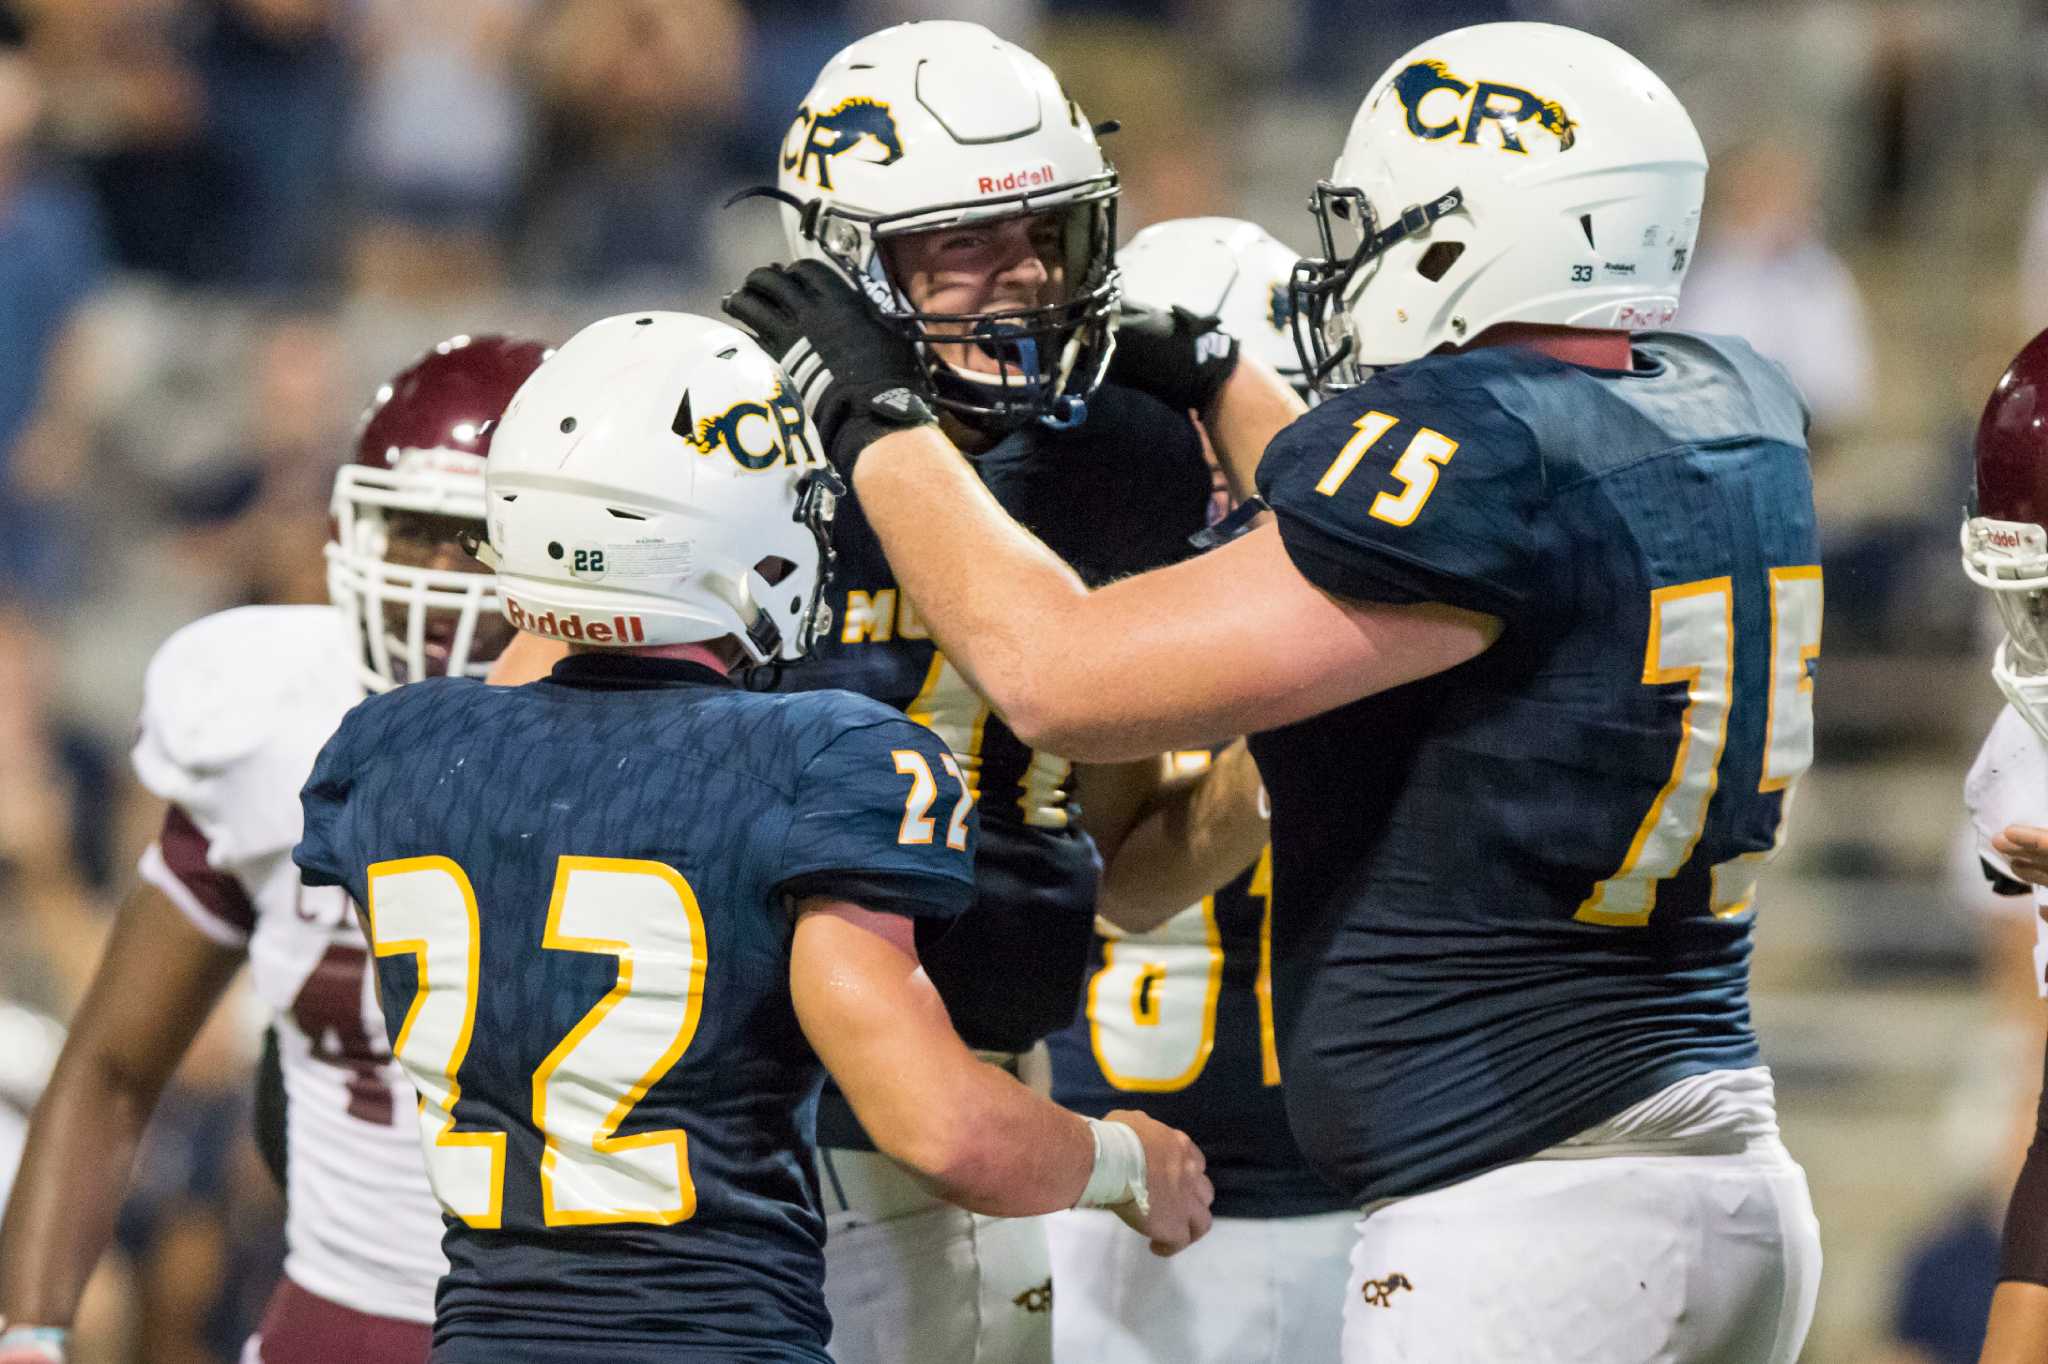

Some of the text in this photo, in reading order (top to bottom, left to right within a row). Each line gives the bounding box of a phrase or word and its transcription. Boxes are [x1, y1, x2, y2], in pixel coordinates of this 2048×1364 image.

[1404, 79, 1529, 156] CR
[977, 165, 1054, 194] Riddell
[1571, 265, 1592, 281] 33
[723, 399, 818, 471] CR
[574, 549, 605, 572] 22
[506, 597, 645, 643] Riddell
[1574, 564, 1825, 927] 75
[891, 750, 974, 852] 22
[367, 854, 708, 1228] 22
